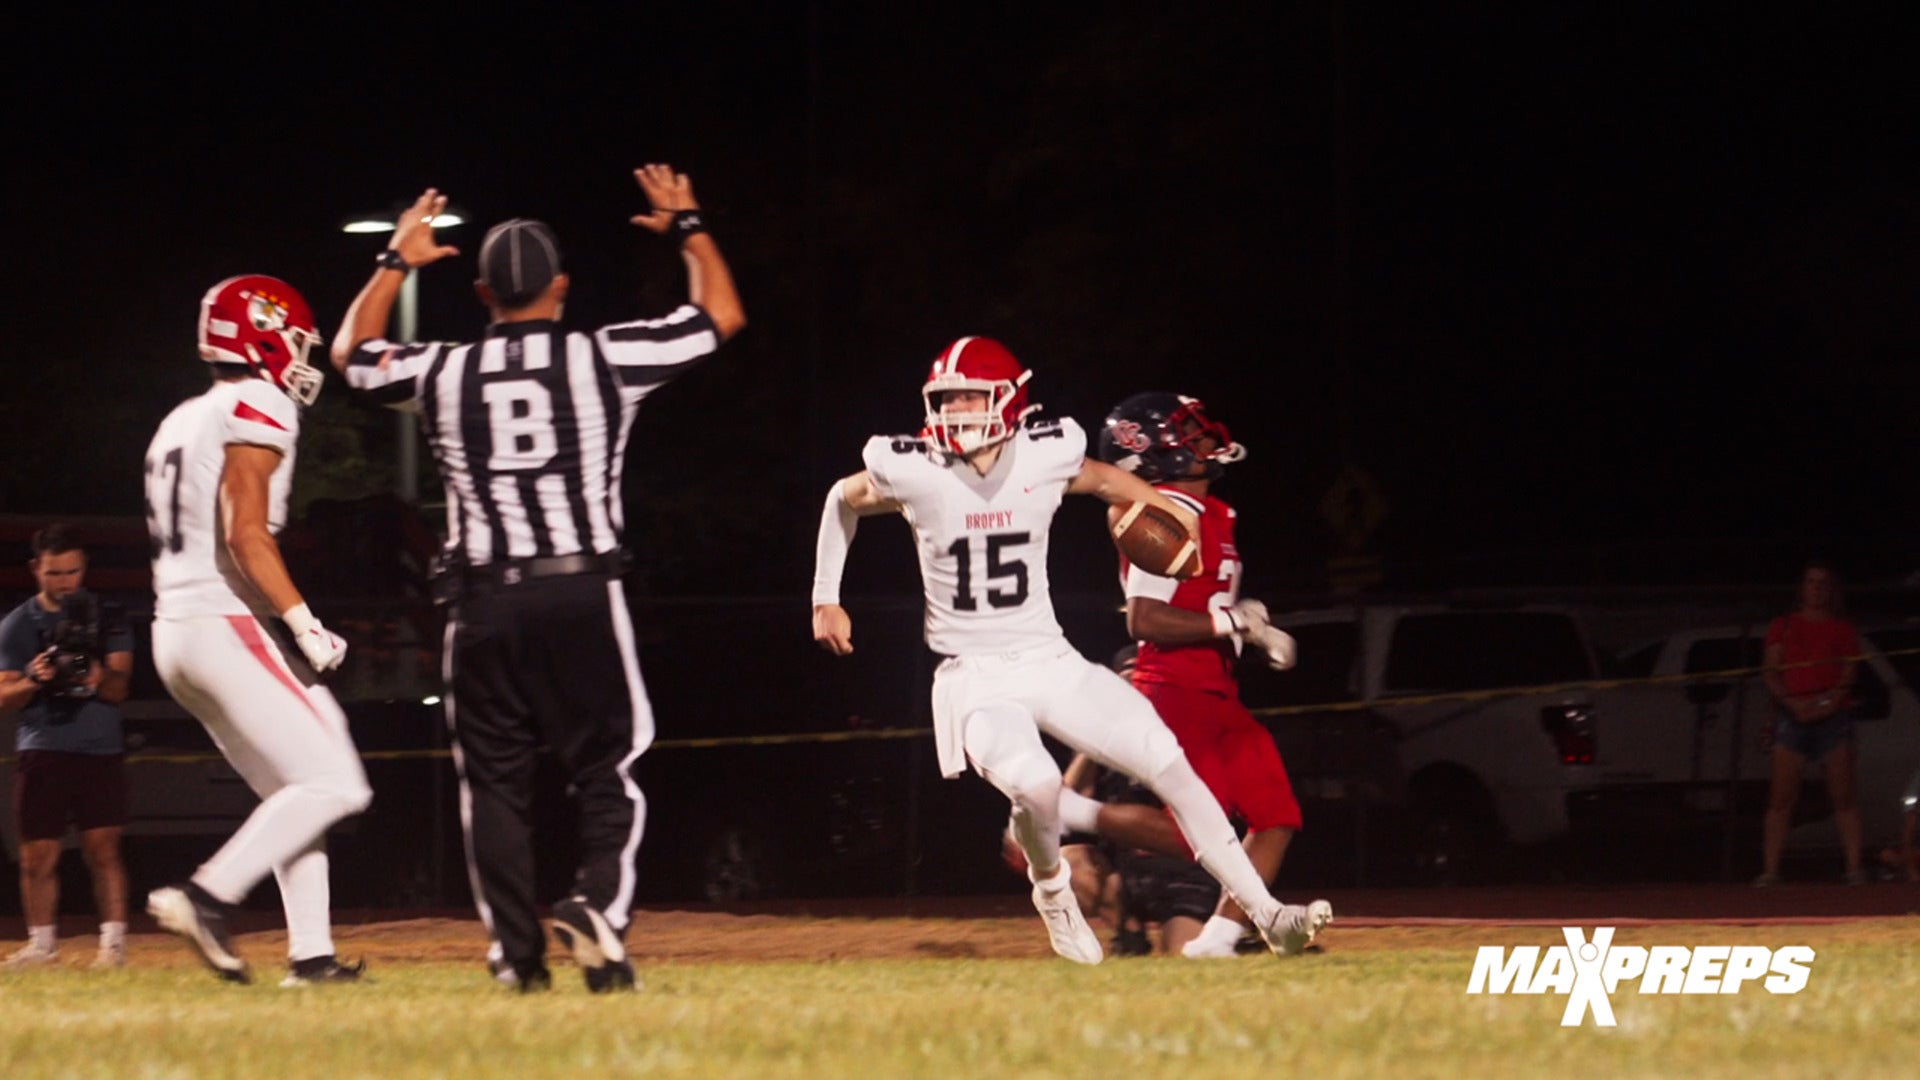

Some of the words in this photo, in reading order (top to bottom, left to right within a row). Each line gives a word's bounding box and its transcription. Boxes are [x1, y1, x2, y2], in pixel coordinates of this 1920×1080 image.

[482, 379, 558, 470] B
[965, 511, 1012, 529] BROPHY
[948, 531, 1030, 611] 15
